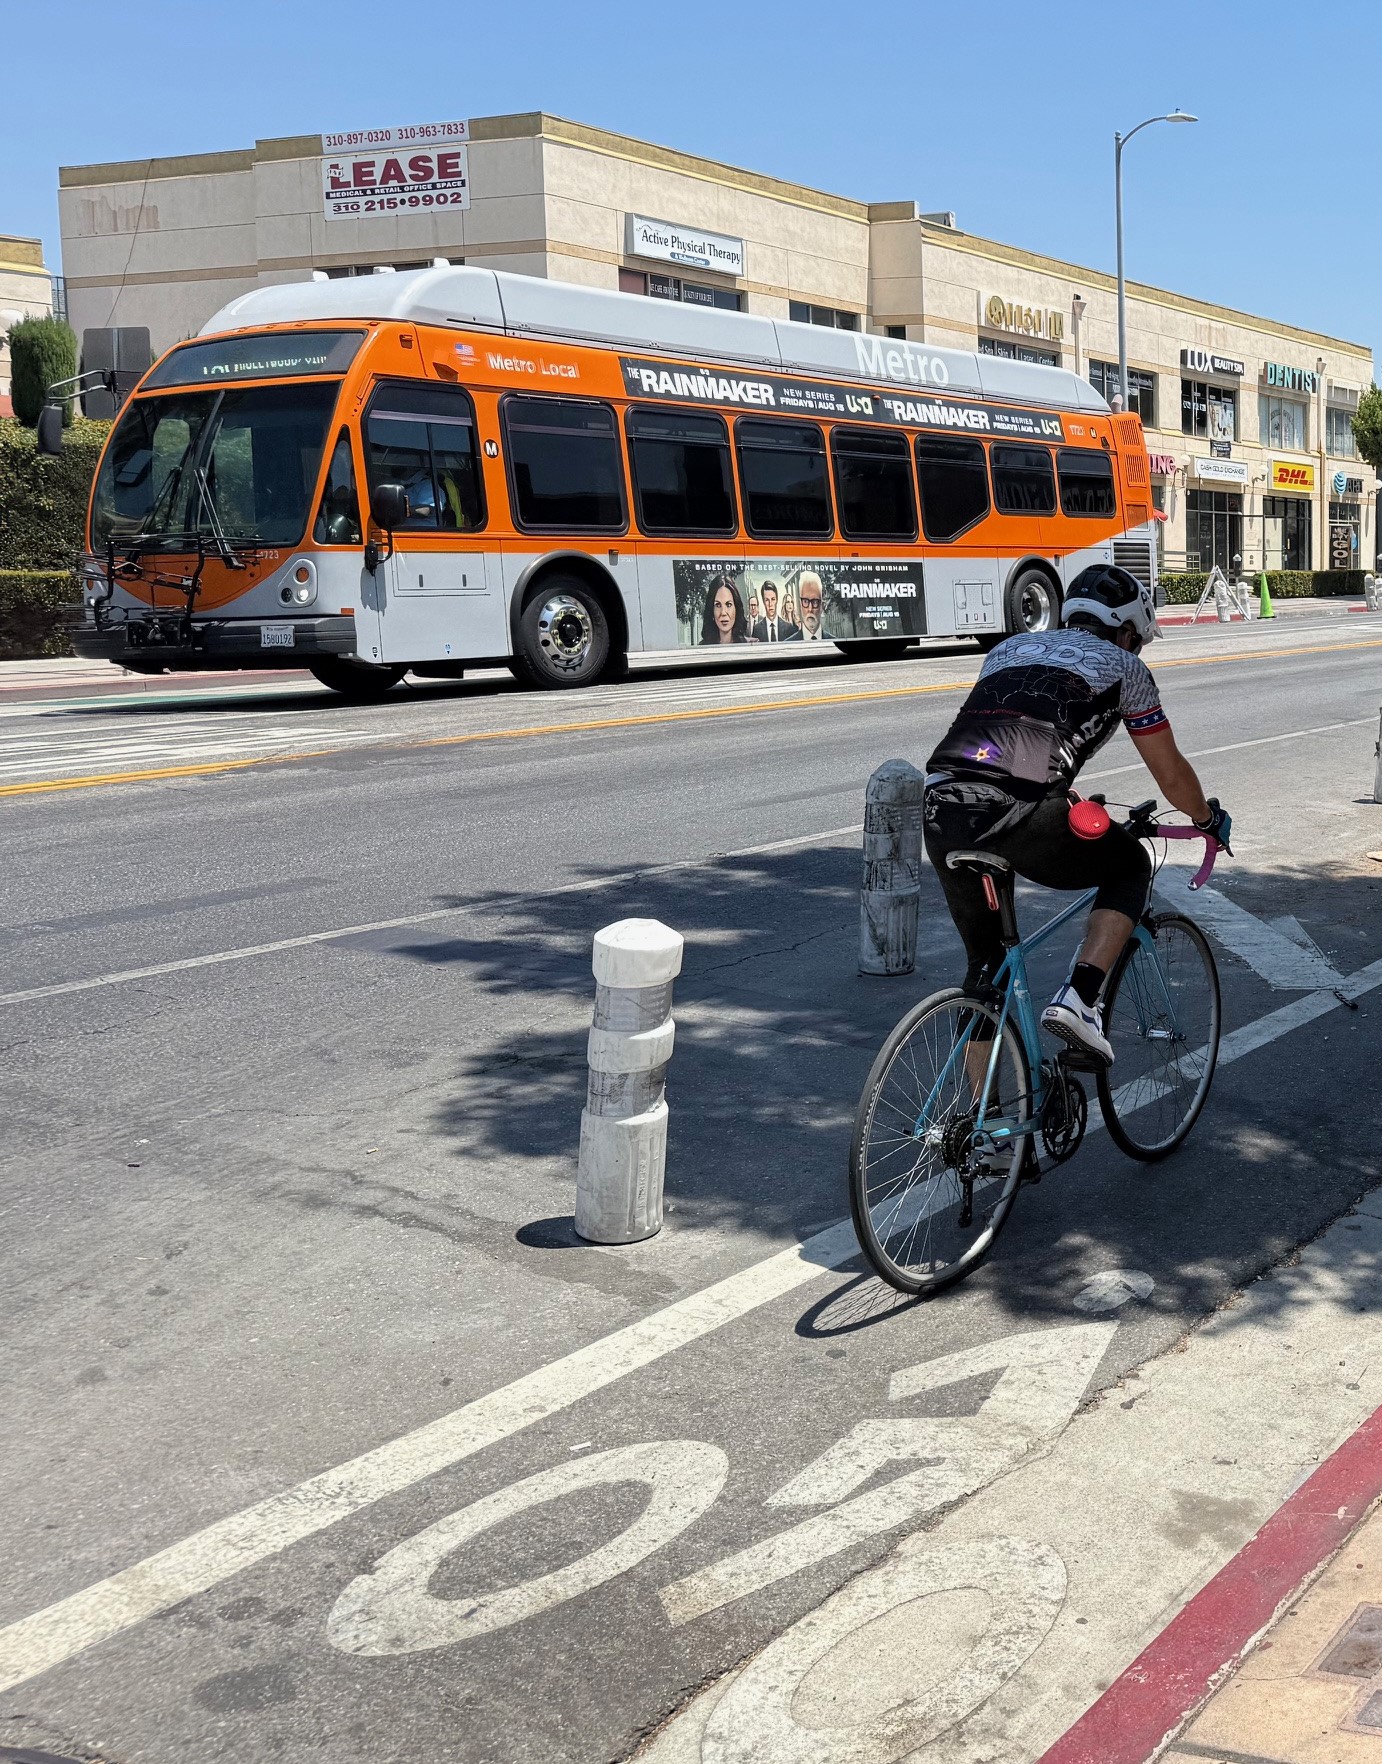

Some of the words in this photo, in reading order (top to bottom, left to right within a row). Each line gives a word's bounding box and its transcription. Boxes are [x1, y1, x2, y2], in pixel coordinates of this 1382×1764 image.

[326, 130, 391, 147] 310-897-0320
[398, 122, 465, 140] 310-963-7833
[330, 152, 462, 190] LEASE
[329, 190, 364, 198] MEDICAL
[404, 184, 432, 192] OFFICE
[436, 181, 463, 189] SPACE
[333, 203, 361, 212] 310
[642, 229, 669, 246] Active
[671, 235, 706, 254] Physical
[708, 243, 741, 264] Therapy
[486, 352, 536, 373] Metro
[540, 358, 580, 378] Local
[853, 335, 949, 387] Metro
[1186, 346, 1214, 374] LUX
[1214, 356, 1233, 371] BEAUTY
[1233, 362, 1244, 374] SPA
[627, 366, 640, 380] THE
[640, 368, 776, 406] RAINMAKER
[1266, 362, 1321, 394] DENTIST
[780, 397, 815, 409] FRIDAYS
[818, 401, 835, 410] AUG
[836, 403, 845, 412] 15
[783, 388, 803, 398] NEW
[805, 390, 836, 401] SERIES
[883, 399, 893, 409] THE
[893, 400, 991, 430] RAINMAKER
[994, 414, 1009, 423] NEW
[1011, 416, 1034, 426] SERIES
[485, 442, 497, 456] M
[1278, 468, 1309, 485] DHL
[1333, 540, 1349, 568] GOL
[757, 564, 812, 572] BEST-SELLING
[841, 582, 916, 598] RAINMAKER
[262, 633, 292, 645] 1580192
